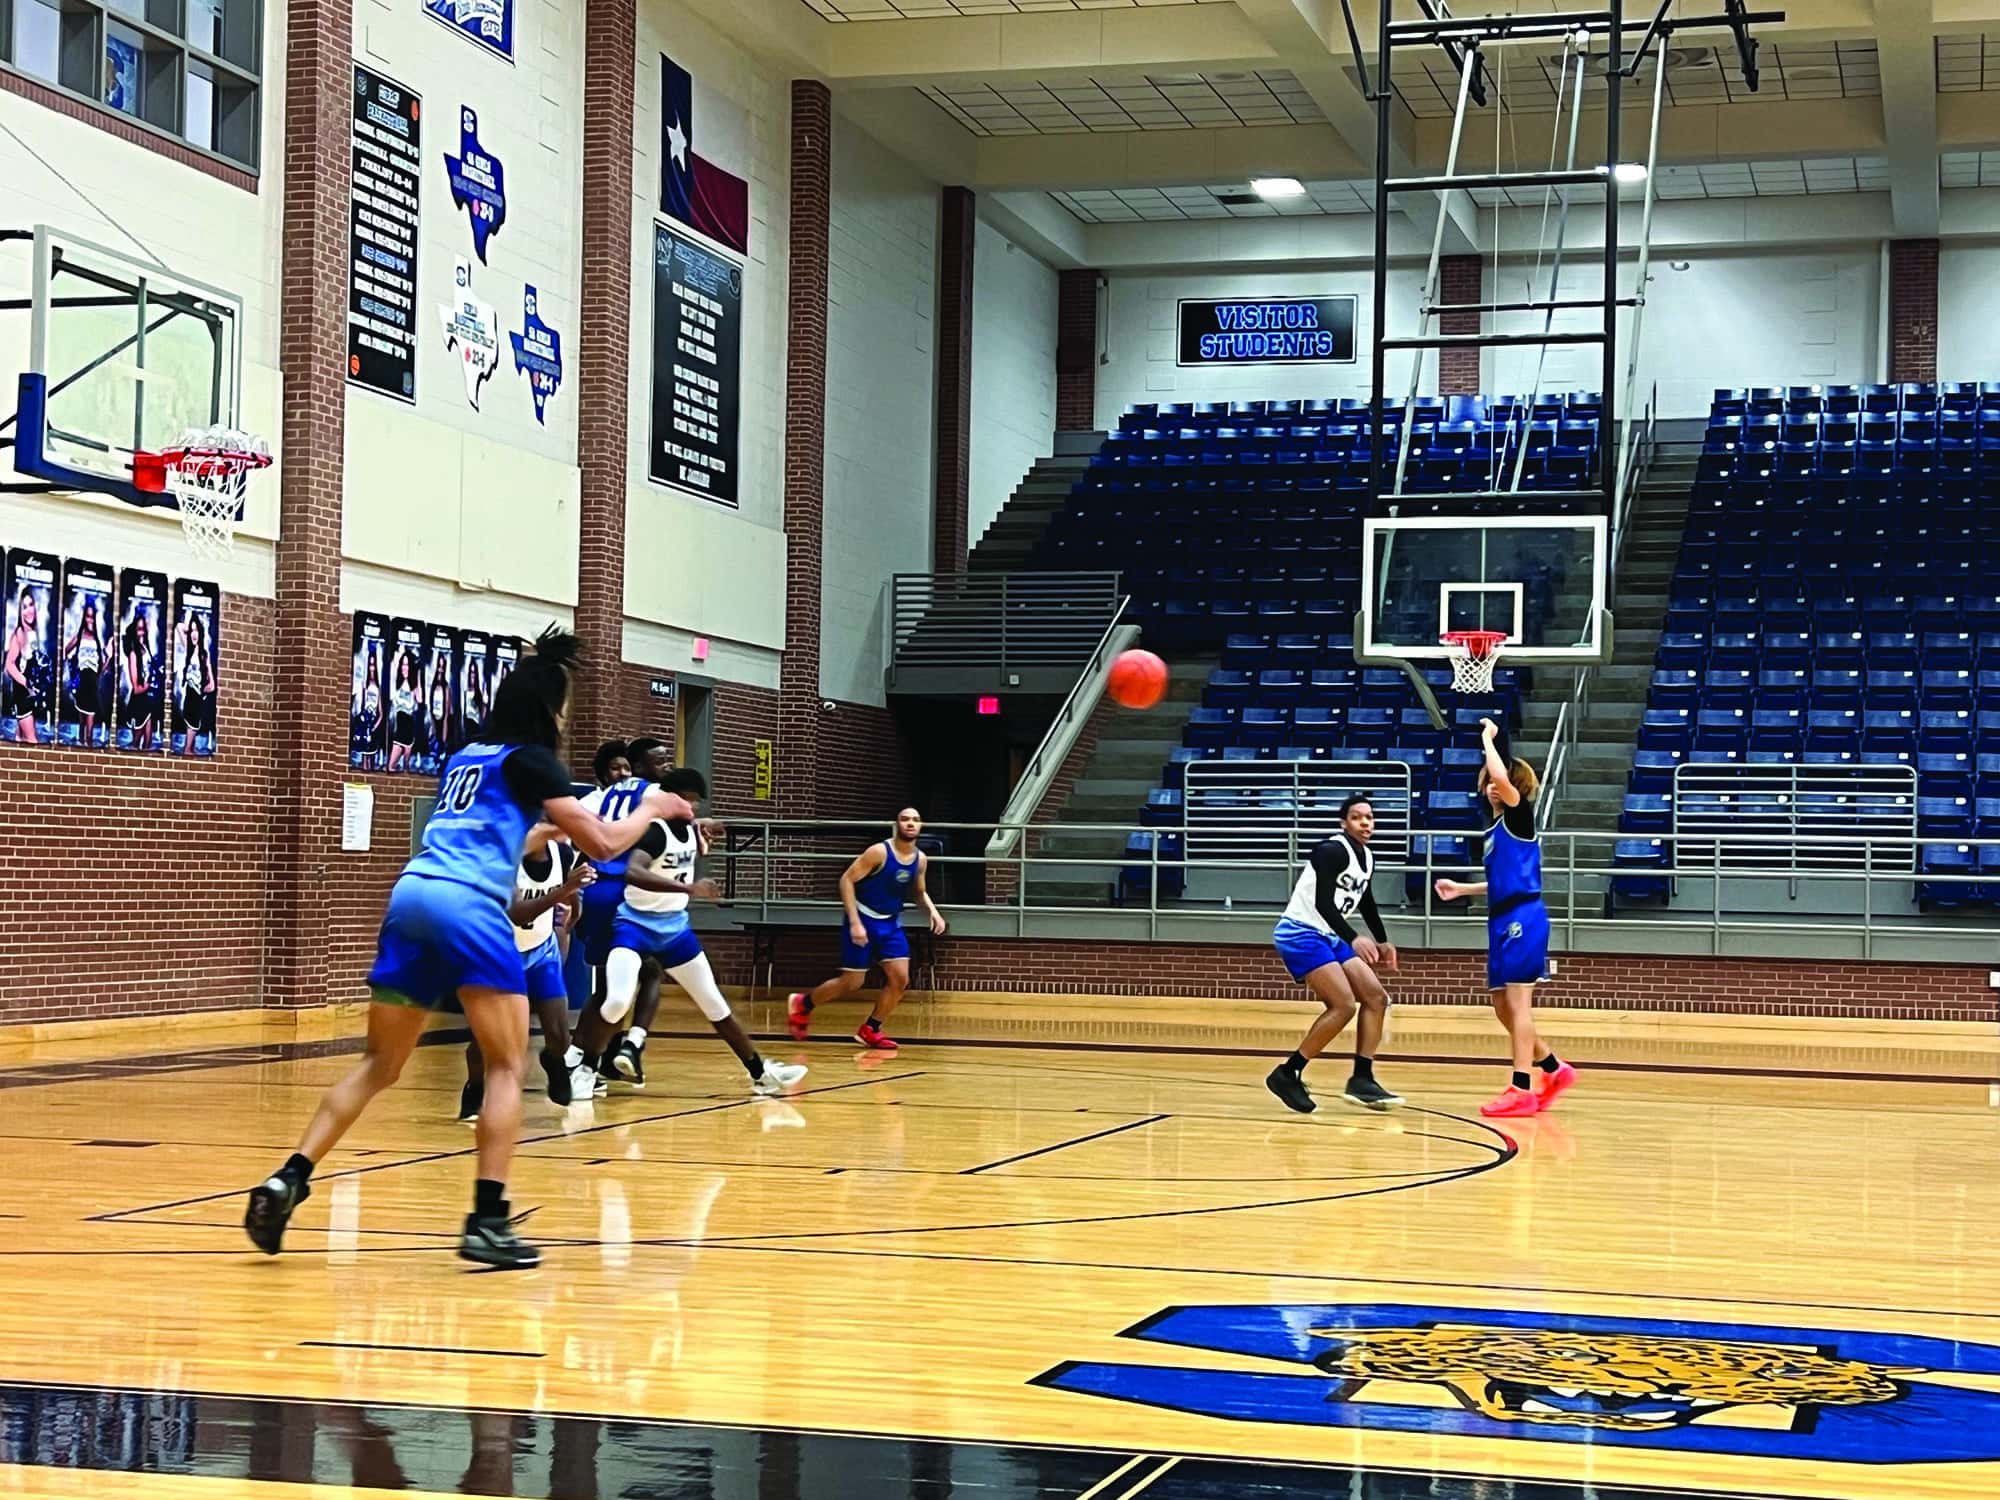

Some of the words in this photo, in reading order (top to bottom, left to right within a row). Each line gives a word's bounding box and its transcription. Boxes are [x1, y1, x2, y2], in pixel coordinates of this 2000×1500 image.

[1215, 304, 1318, 329] VISITOR
[1200, 331, 1333, 358] STUDENTS
[433, 764, 484, 815] 10
